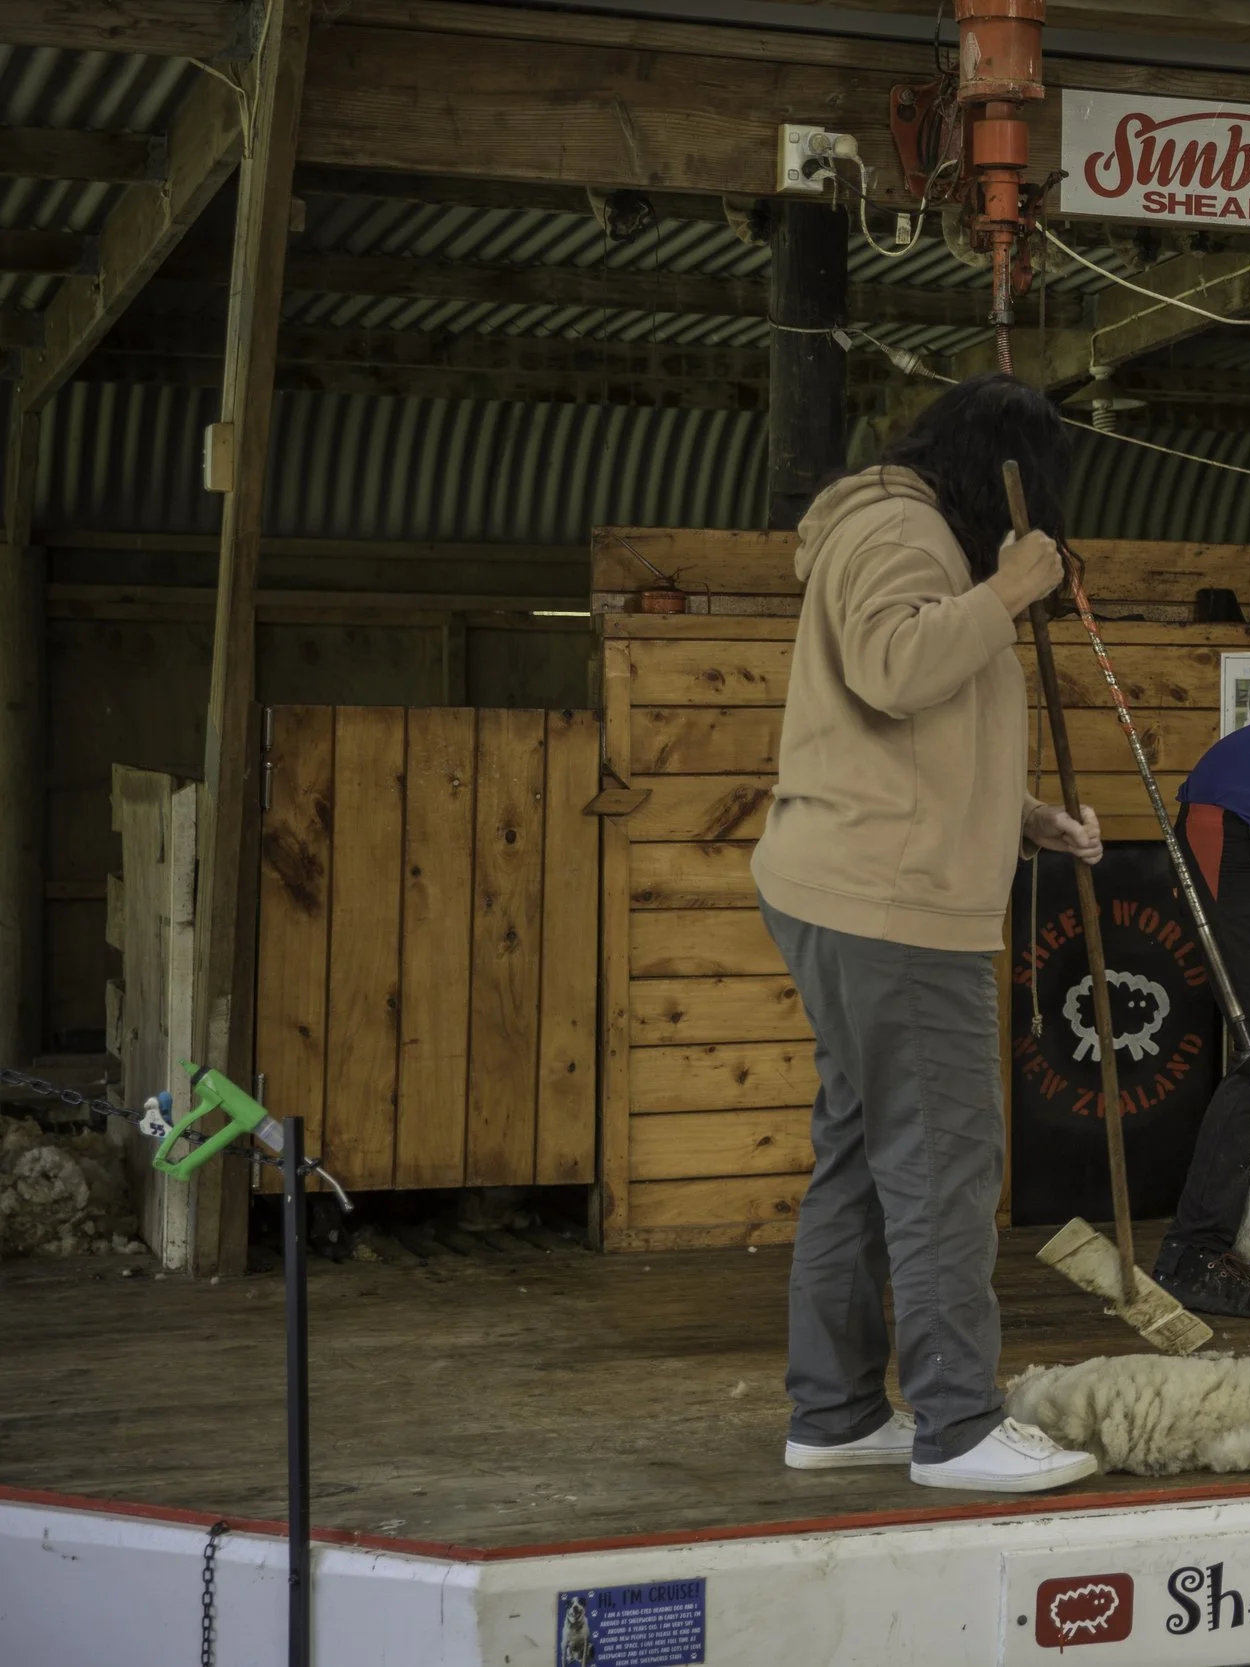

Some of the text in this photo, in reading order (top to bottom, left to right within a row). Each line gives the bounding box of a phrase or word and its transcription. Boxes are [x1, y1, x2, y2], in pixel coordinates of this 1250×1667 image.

[1013, 899, 1207, 988] SHEE WORLD
[1013, 1034, 1068, 1100] NEW
[622, 1589, 642, 1605] I'M
